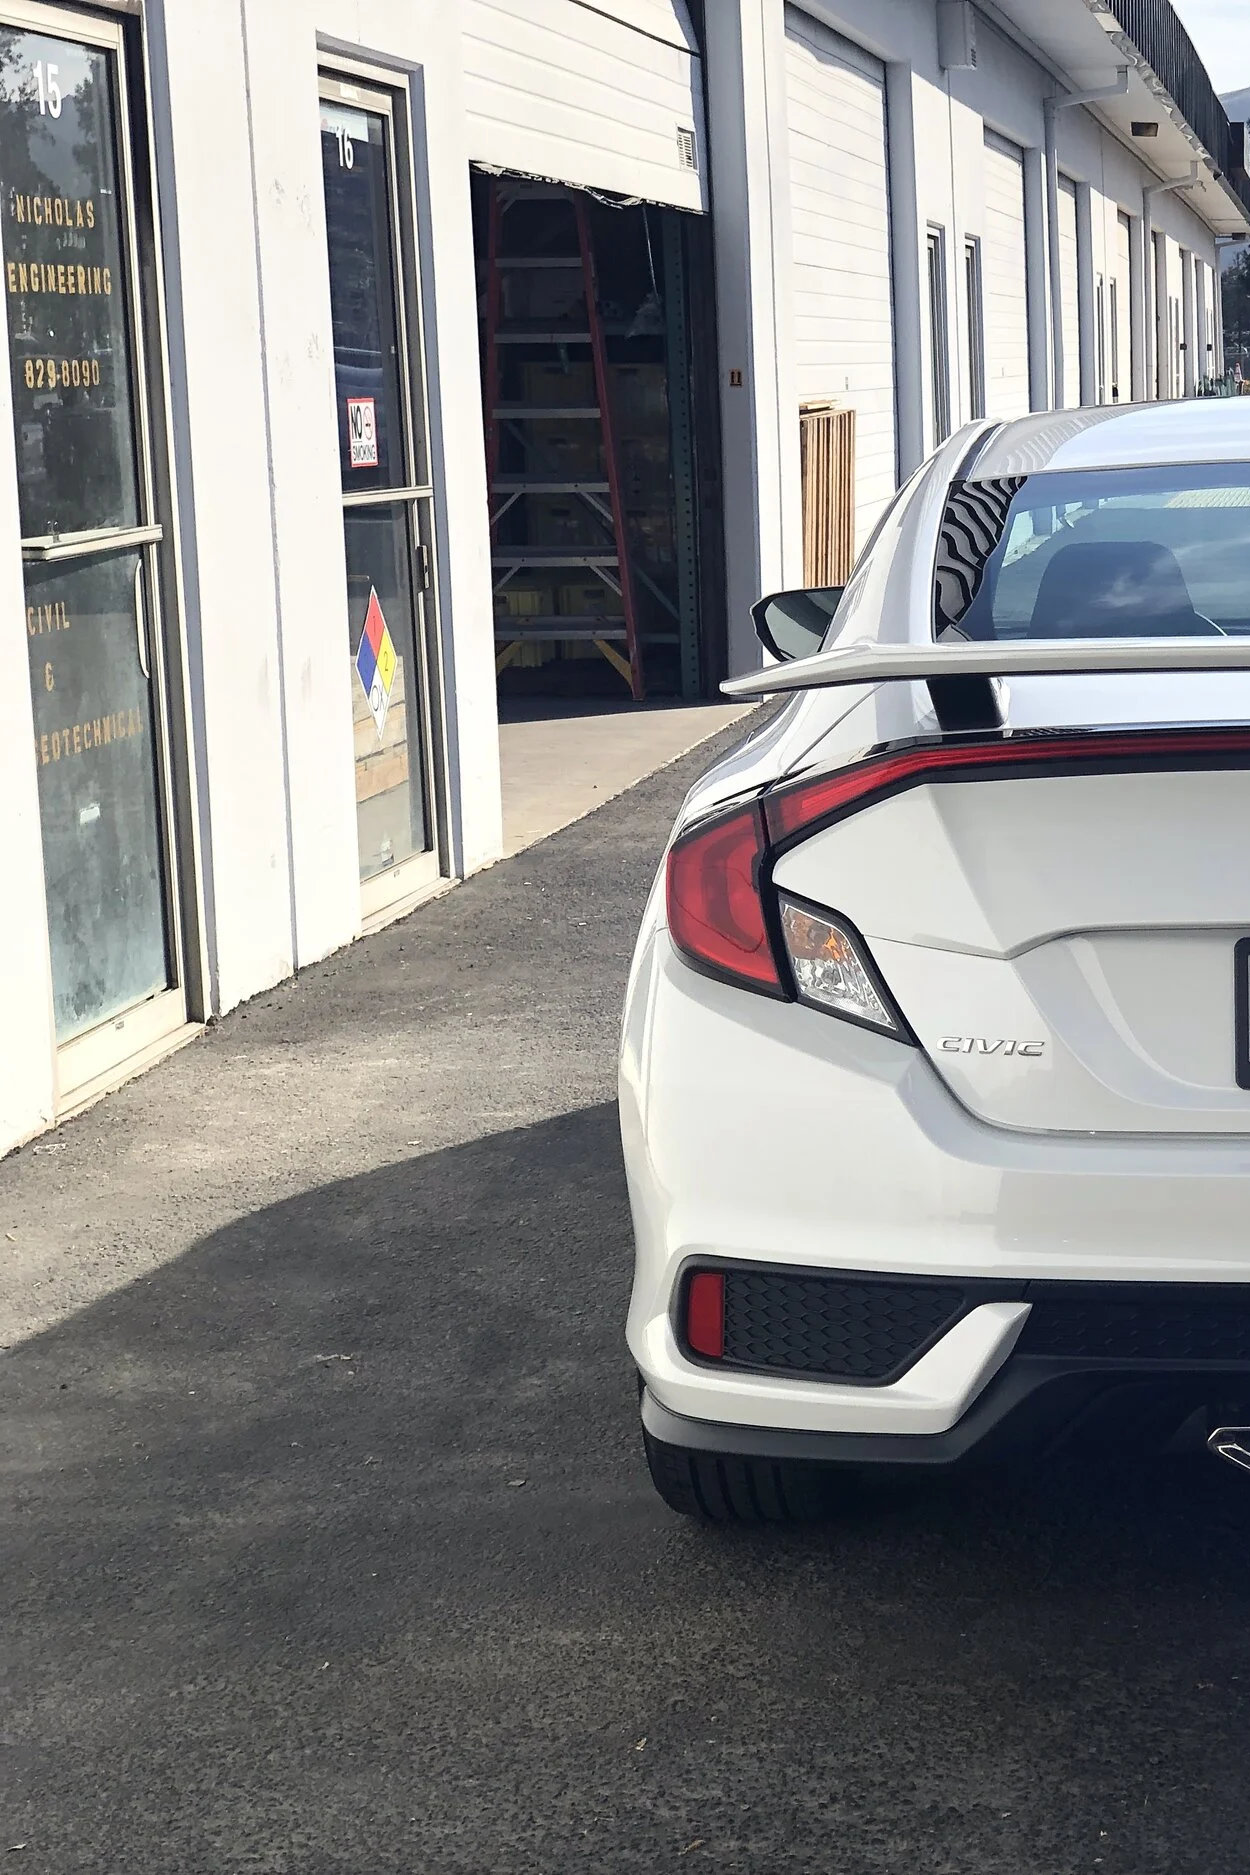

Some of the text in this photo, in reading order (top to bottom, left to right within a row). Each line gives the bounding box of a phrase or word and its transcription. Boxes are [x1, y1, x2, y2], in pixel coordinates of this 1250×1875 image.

[33, 60, 62, 119] 15
[335, 126, 354, 170] 16
[16, 194, 95, 229] NICHOLAS
[7, 262, 112, 295] ENGINEERING
[25, 359, 100, 389] 829-8090
[350, 405, 363, 440] NO
[352, 443, 376, 462] SMOKING
[27, 601, 70, 636] CIVIL
[383, 650, 389, 672] 2
[35, 702, 144, 766] EOTECHNICAL
[937, 1036, 1045, 1057] CIVIC
